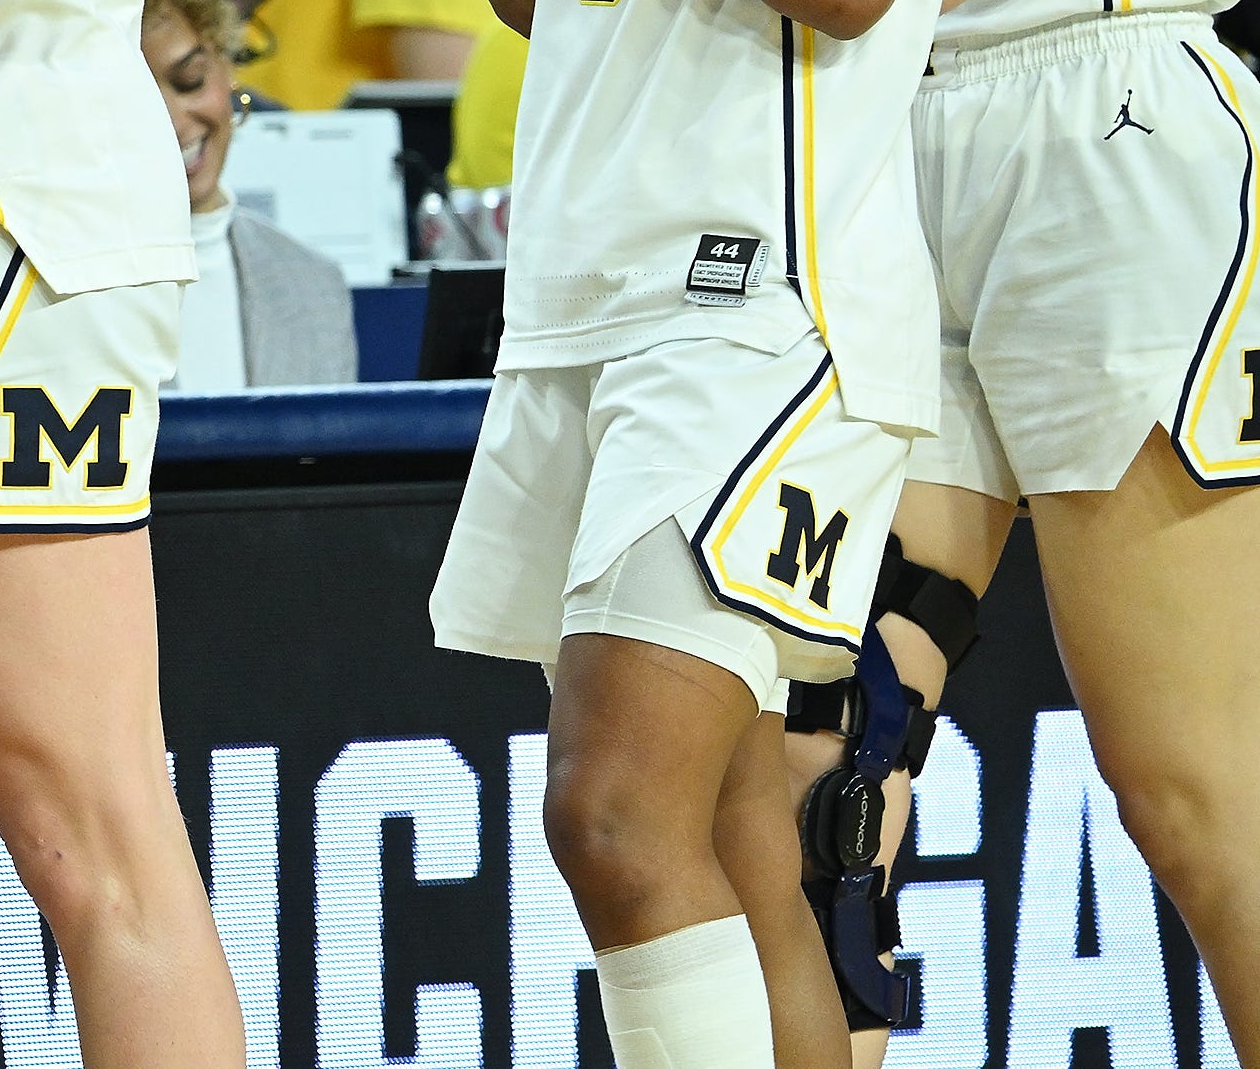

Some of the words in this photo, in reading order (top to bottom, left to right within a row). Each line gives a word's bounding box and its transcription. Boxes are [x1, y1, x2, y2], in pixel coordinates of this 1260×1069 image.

[710, 242, 740, 259] 44
[766, 479, 851, 613] M
[855, 790, 869, 854] DONJOY
